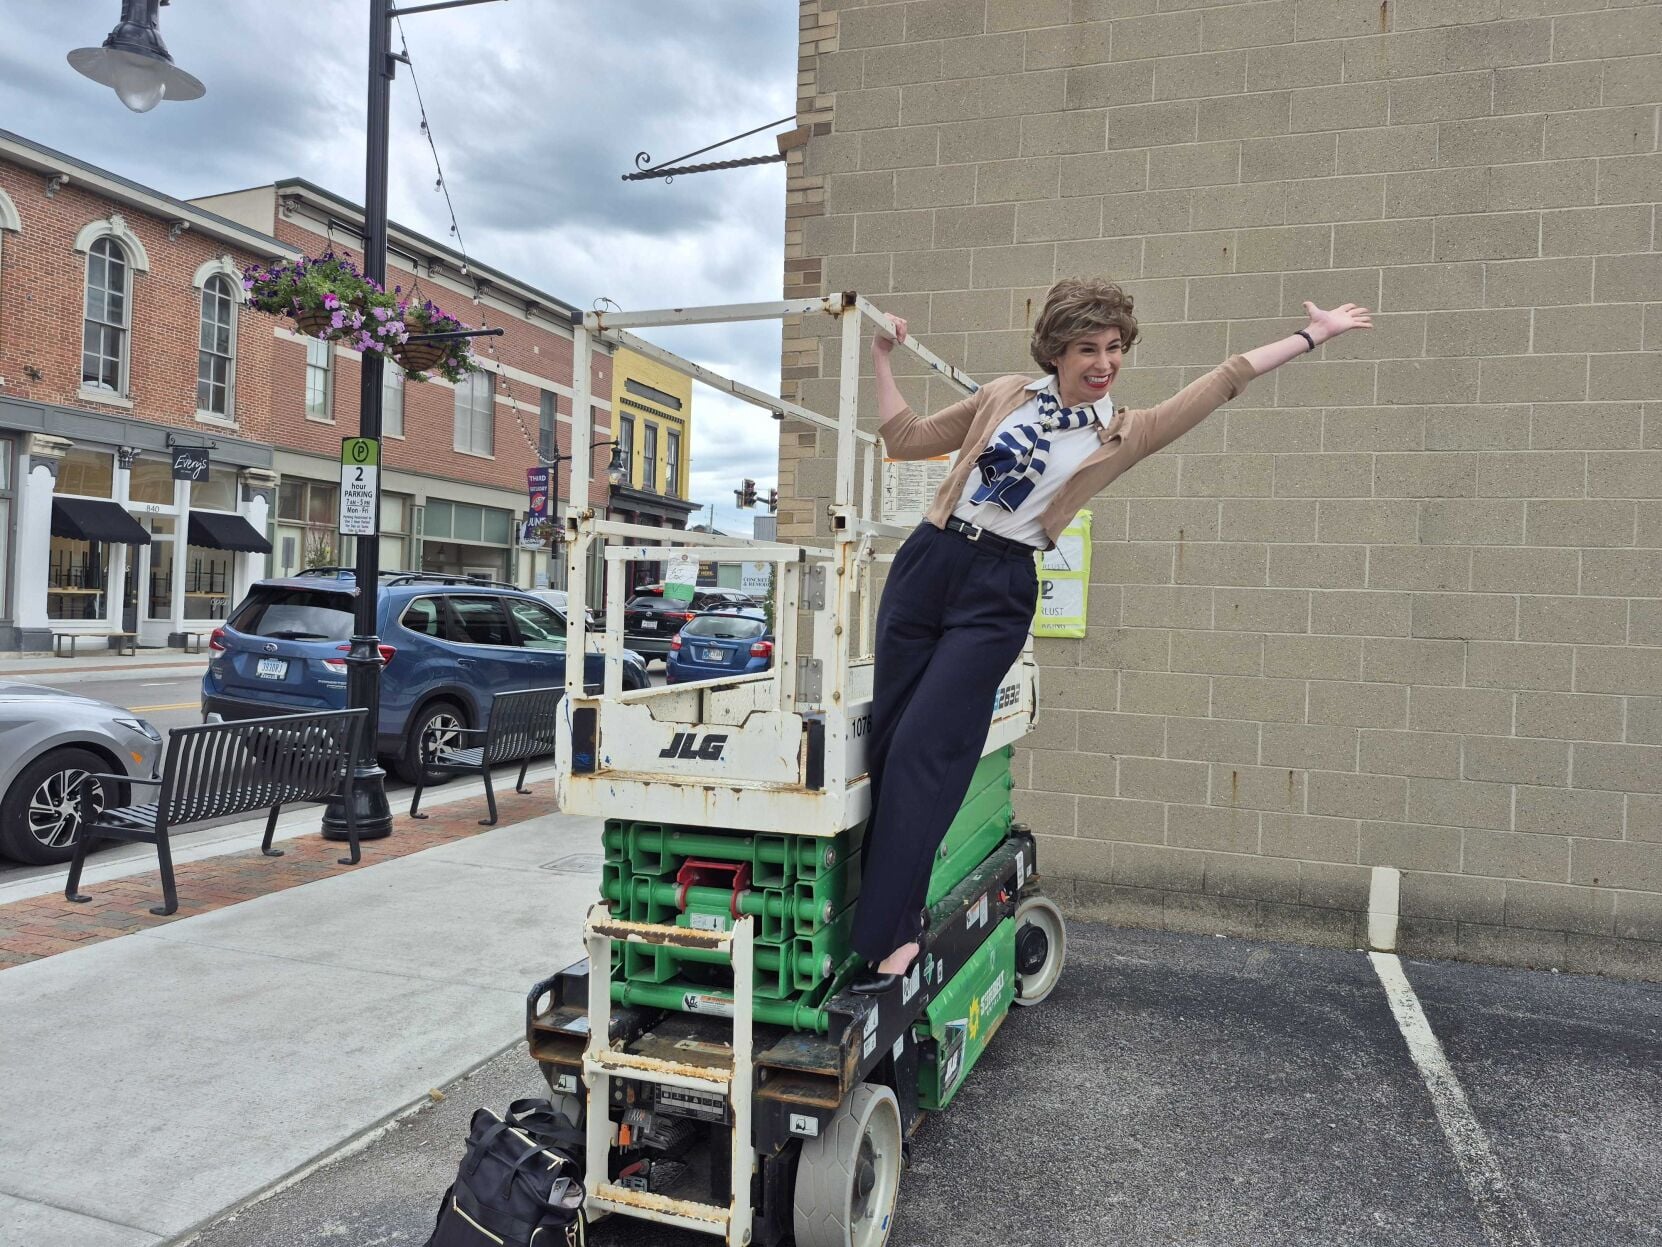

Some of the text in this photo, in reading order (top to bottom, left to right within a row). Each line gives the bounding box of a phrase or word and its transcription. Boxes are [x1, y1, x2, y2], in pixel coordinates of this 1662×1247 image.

[355, 466, 364, 482] 2
[351, 482, 367, 490] hour
[344, 490, 373, 499] PARKING
[346, 506, 359, 514] Mon
[361, 506, 369, 514] Fri
[659, 732, 729, 761] JLG
